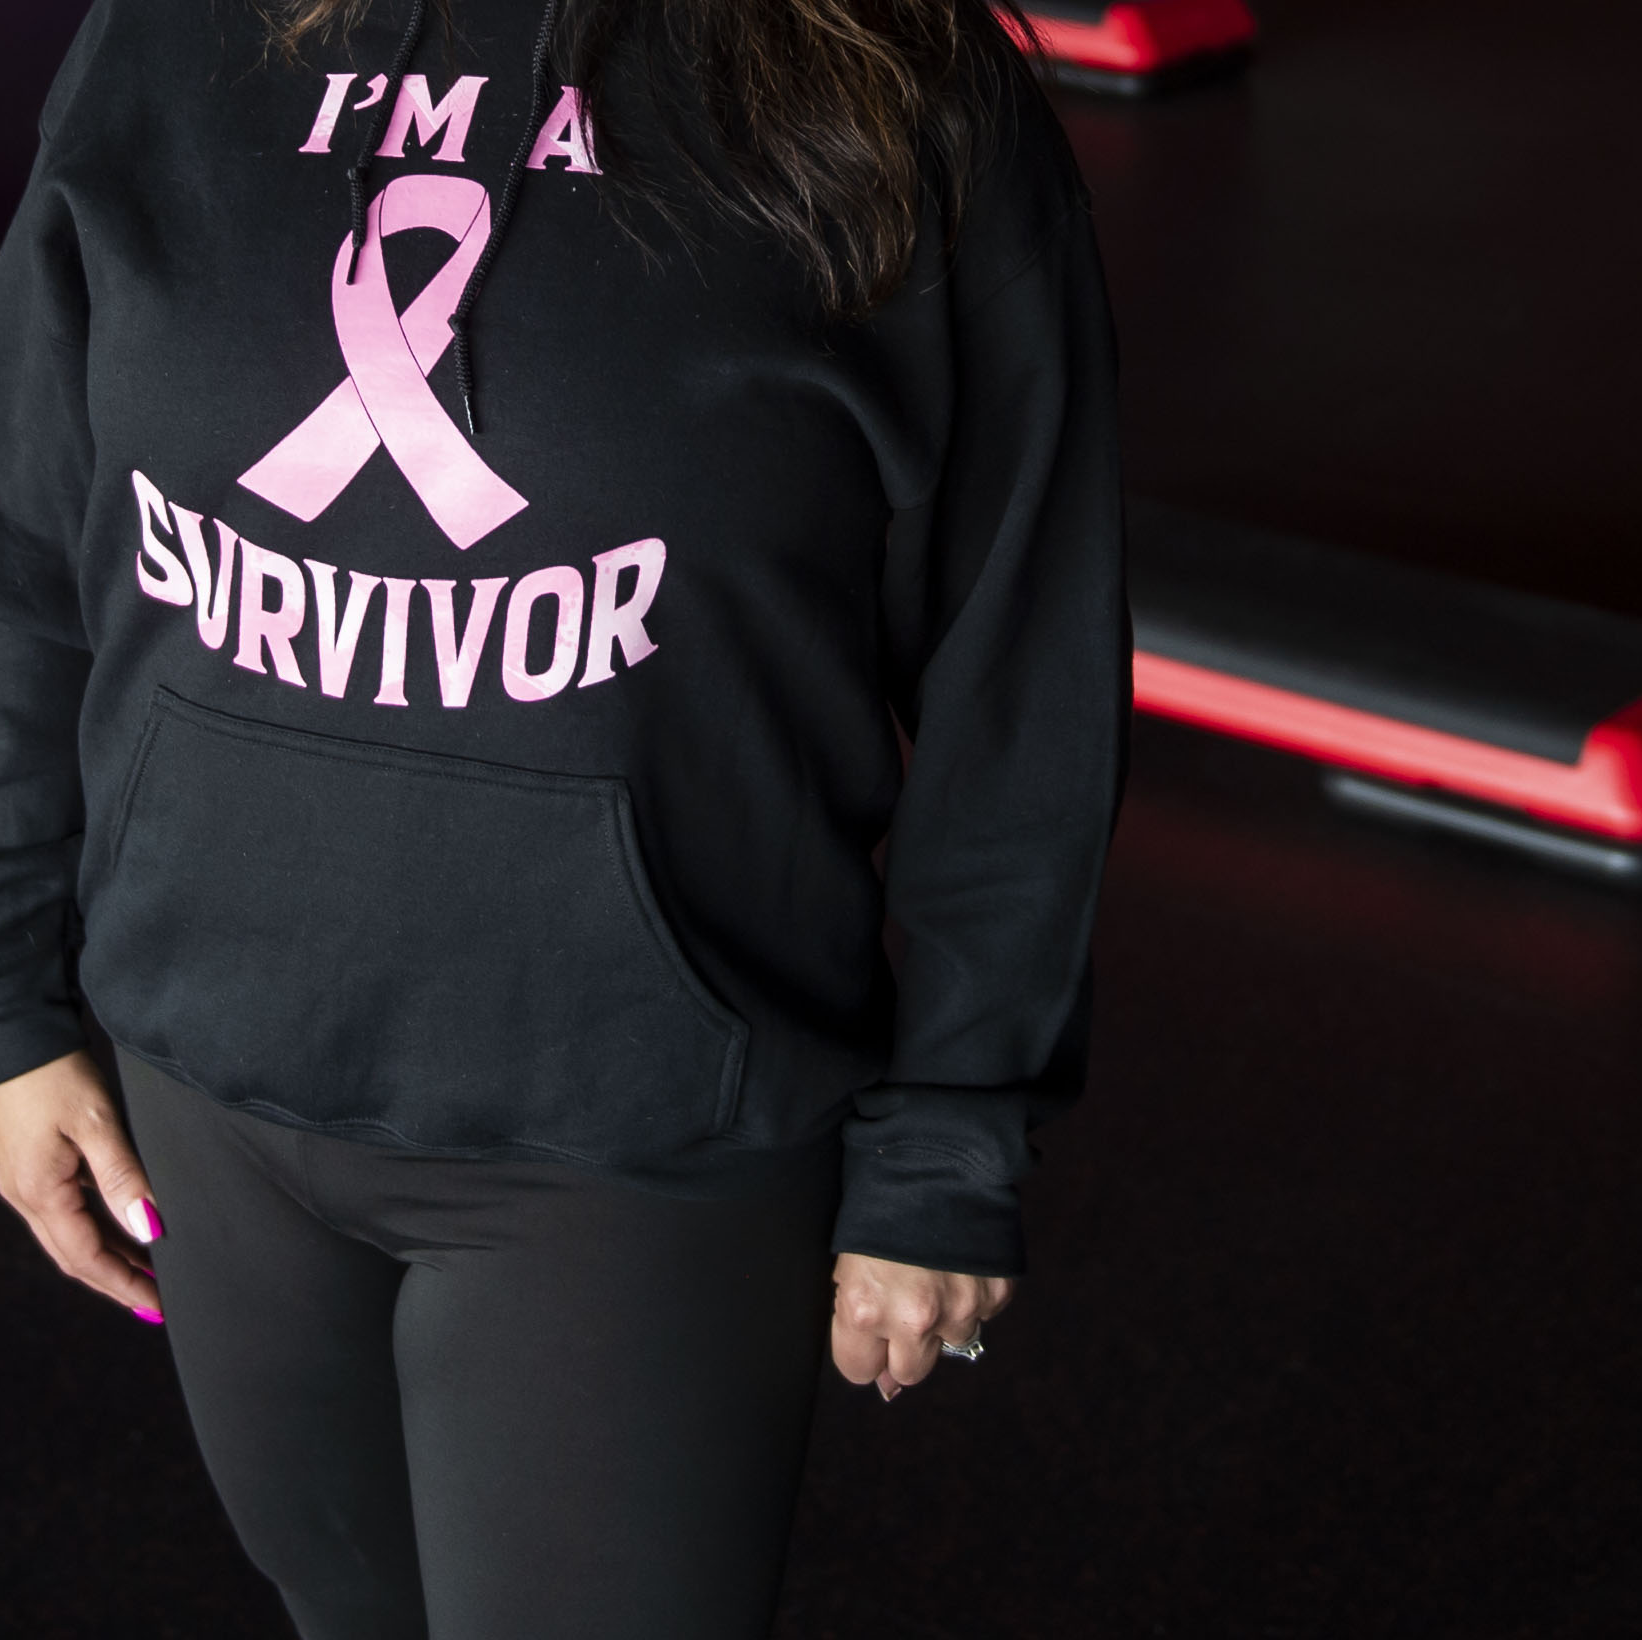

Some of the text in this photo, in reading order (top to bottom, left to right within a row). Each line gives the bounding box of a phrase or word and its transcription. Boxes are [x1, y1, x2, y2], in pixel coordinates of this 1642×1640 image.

[299, 73, 604, 175] I'M A
[132, 470, 667, 708] SURVIVOR
